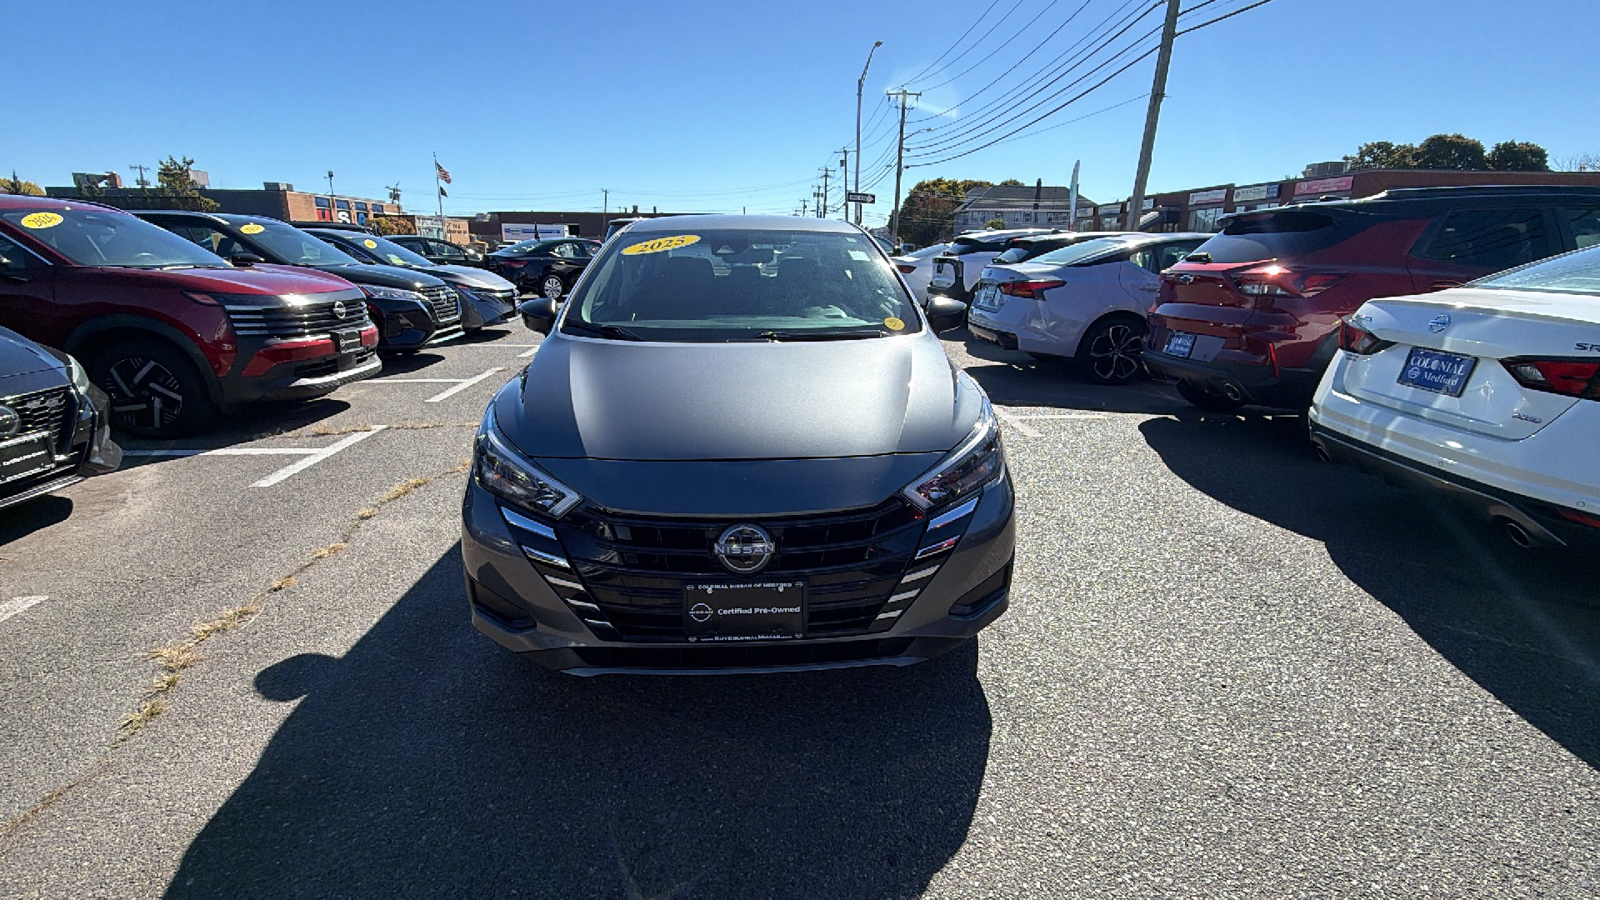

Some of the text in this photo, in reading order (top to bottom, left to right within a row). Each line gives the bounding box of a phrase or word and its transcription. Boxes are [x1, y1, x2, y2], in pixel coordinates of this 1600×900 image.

[637, 236, 685, 253] 2025
[1410, 356, 1466, 376] COLONIAL
[1422, 371, 1459, 386] Medford
[714, 543, 774, 555] NISSAN
[717, 606, 801, 615] Certified Pre-Owned
